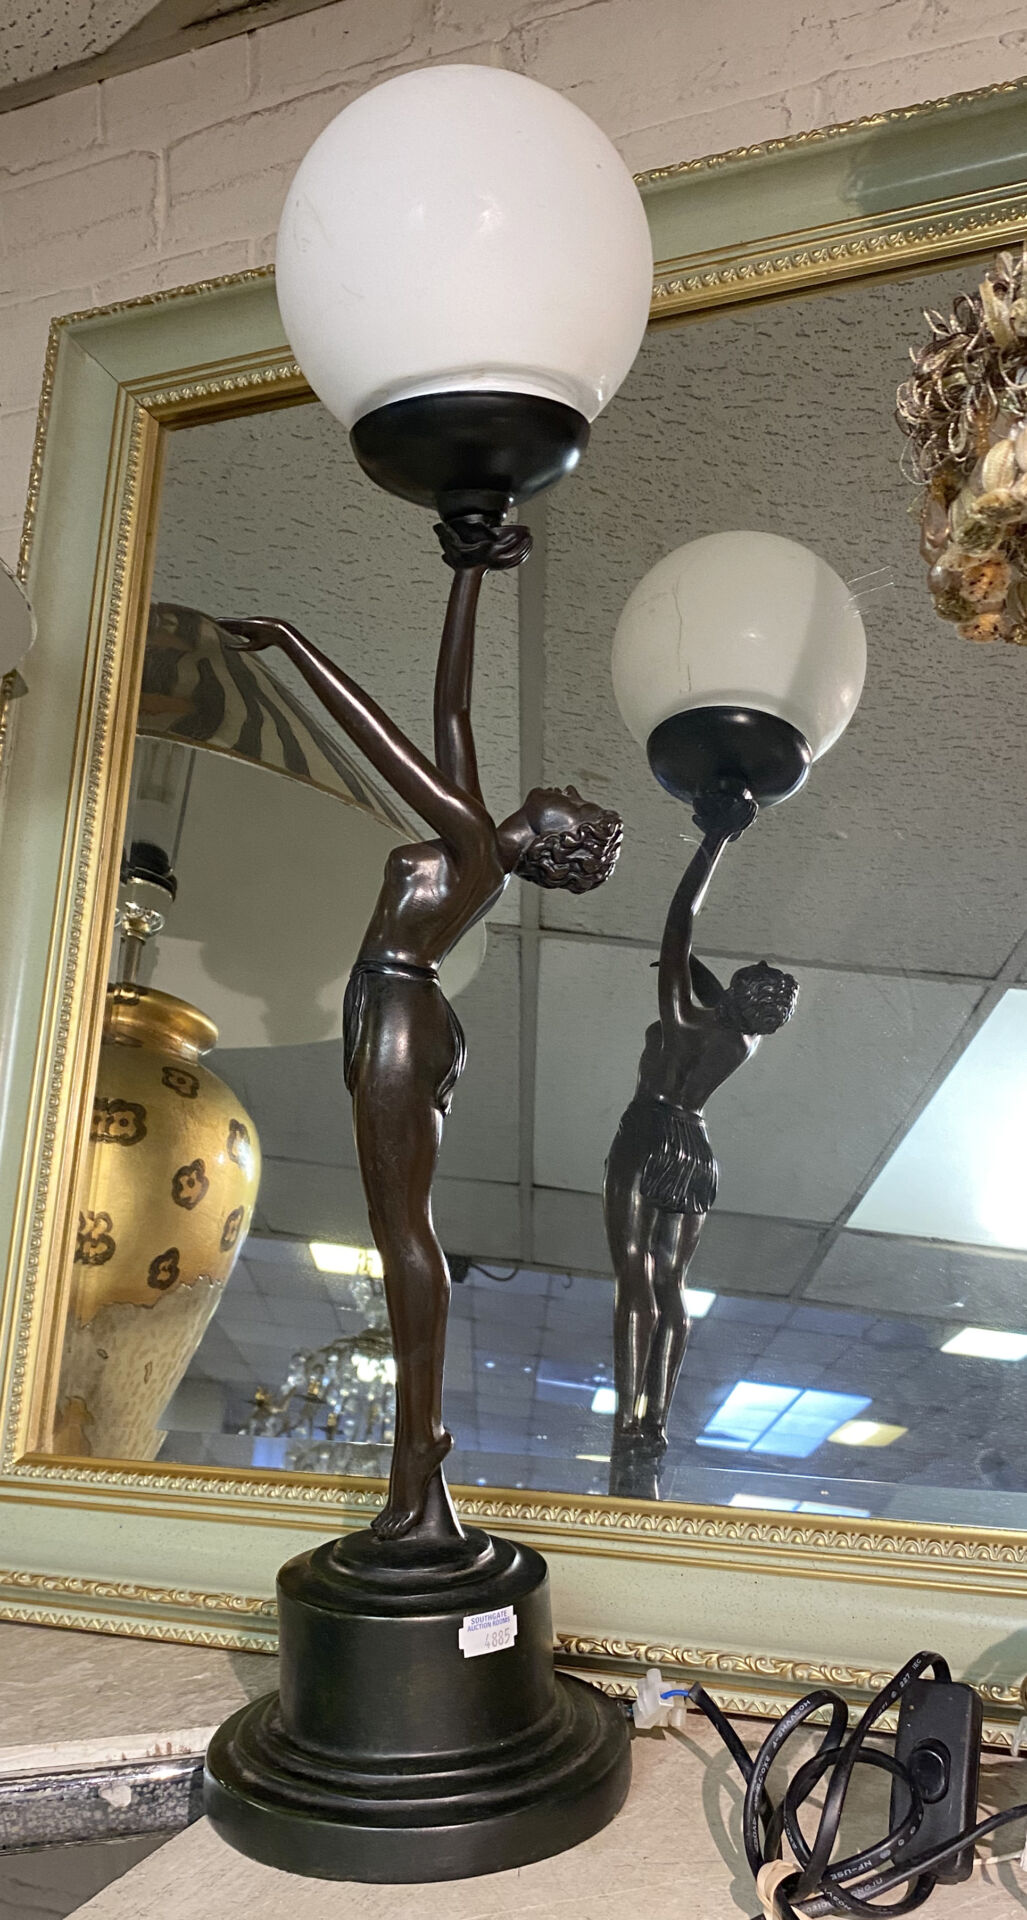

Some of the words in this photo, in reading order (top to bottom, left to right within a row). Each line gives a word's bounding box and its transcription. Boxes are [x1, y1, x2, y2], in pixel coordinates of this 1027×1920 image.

[467, 1622, 491, 1632] AUCTION
[492, 1616, 510, 1627] ROOMS
[471, 1609, 507, 1625] SOUTHGATE
[484, 1627, 510, 1648] 4885
[912, 1658, 921, 1670] IEC
